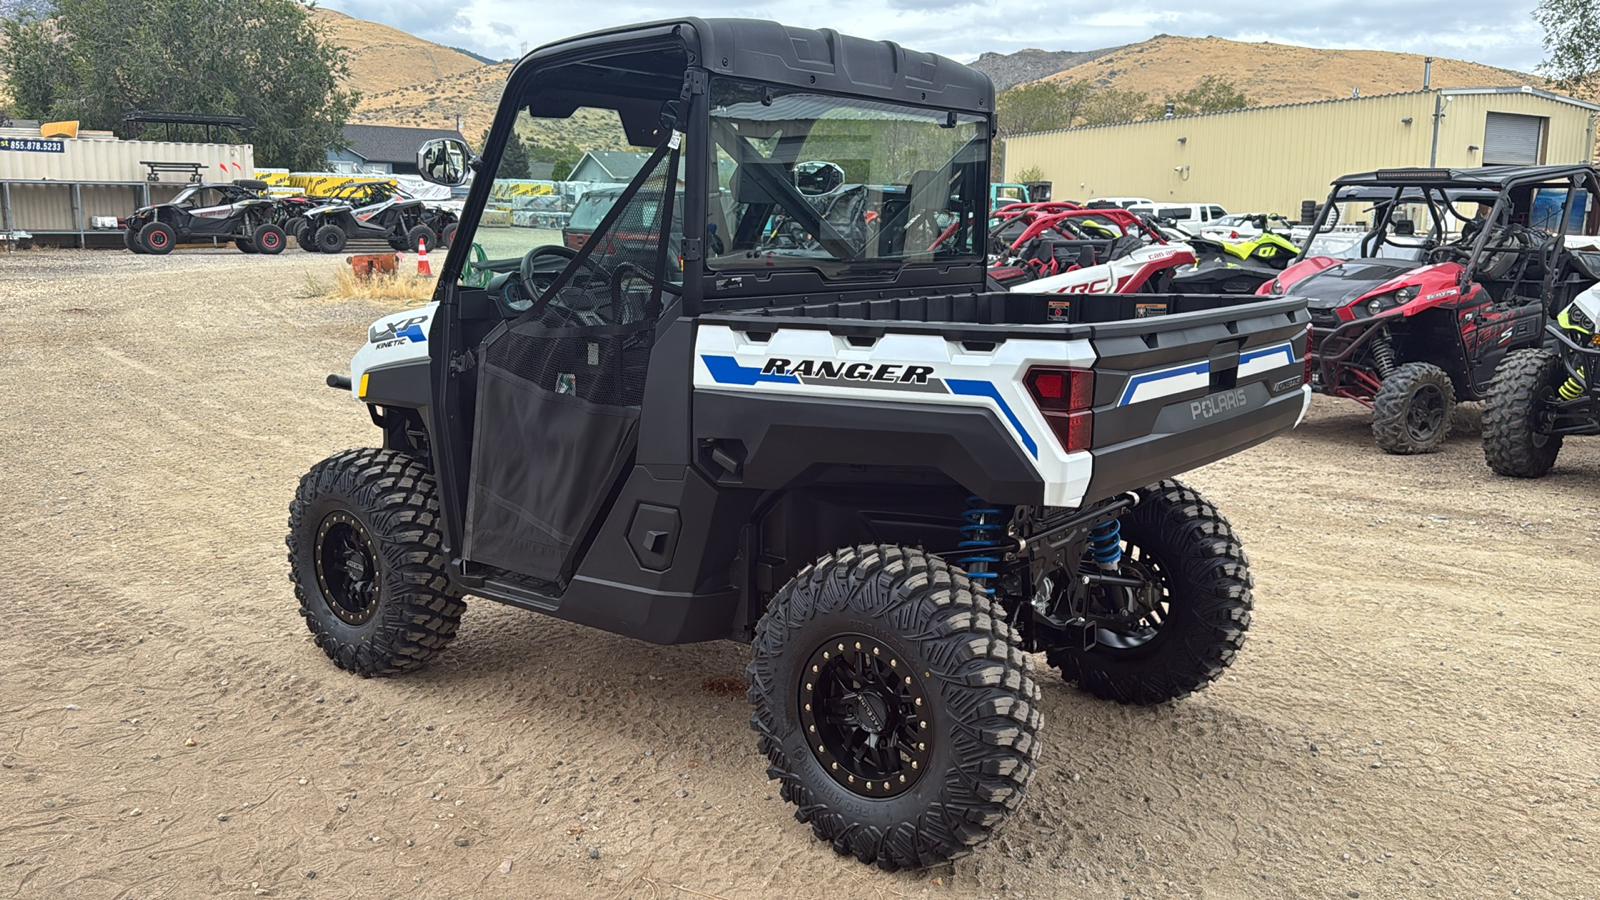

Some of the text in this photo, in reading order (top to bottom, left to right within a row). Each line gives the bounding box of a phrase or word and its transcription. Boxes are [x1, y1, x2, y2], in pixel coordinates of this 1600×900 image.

[10, 141, 61, 151] 855.878.5233
[375, 338, 407, 350] KINETIC
[761, 357, 935, 384] RANGER
[1190, 389, 1247, 421] POLARIS
